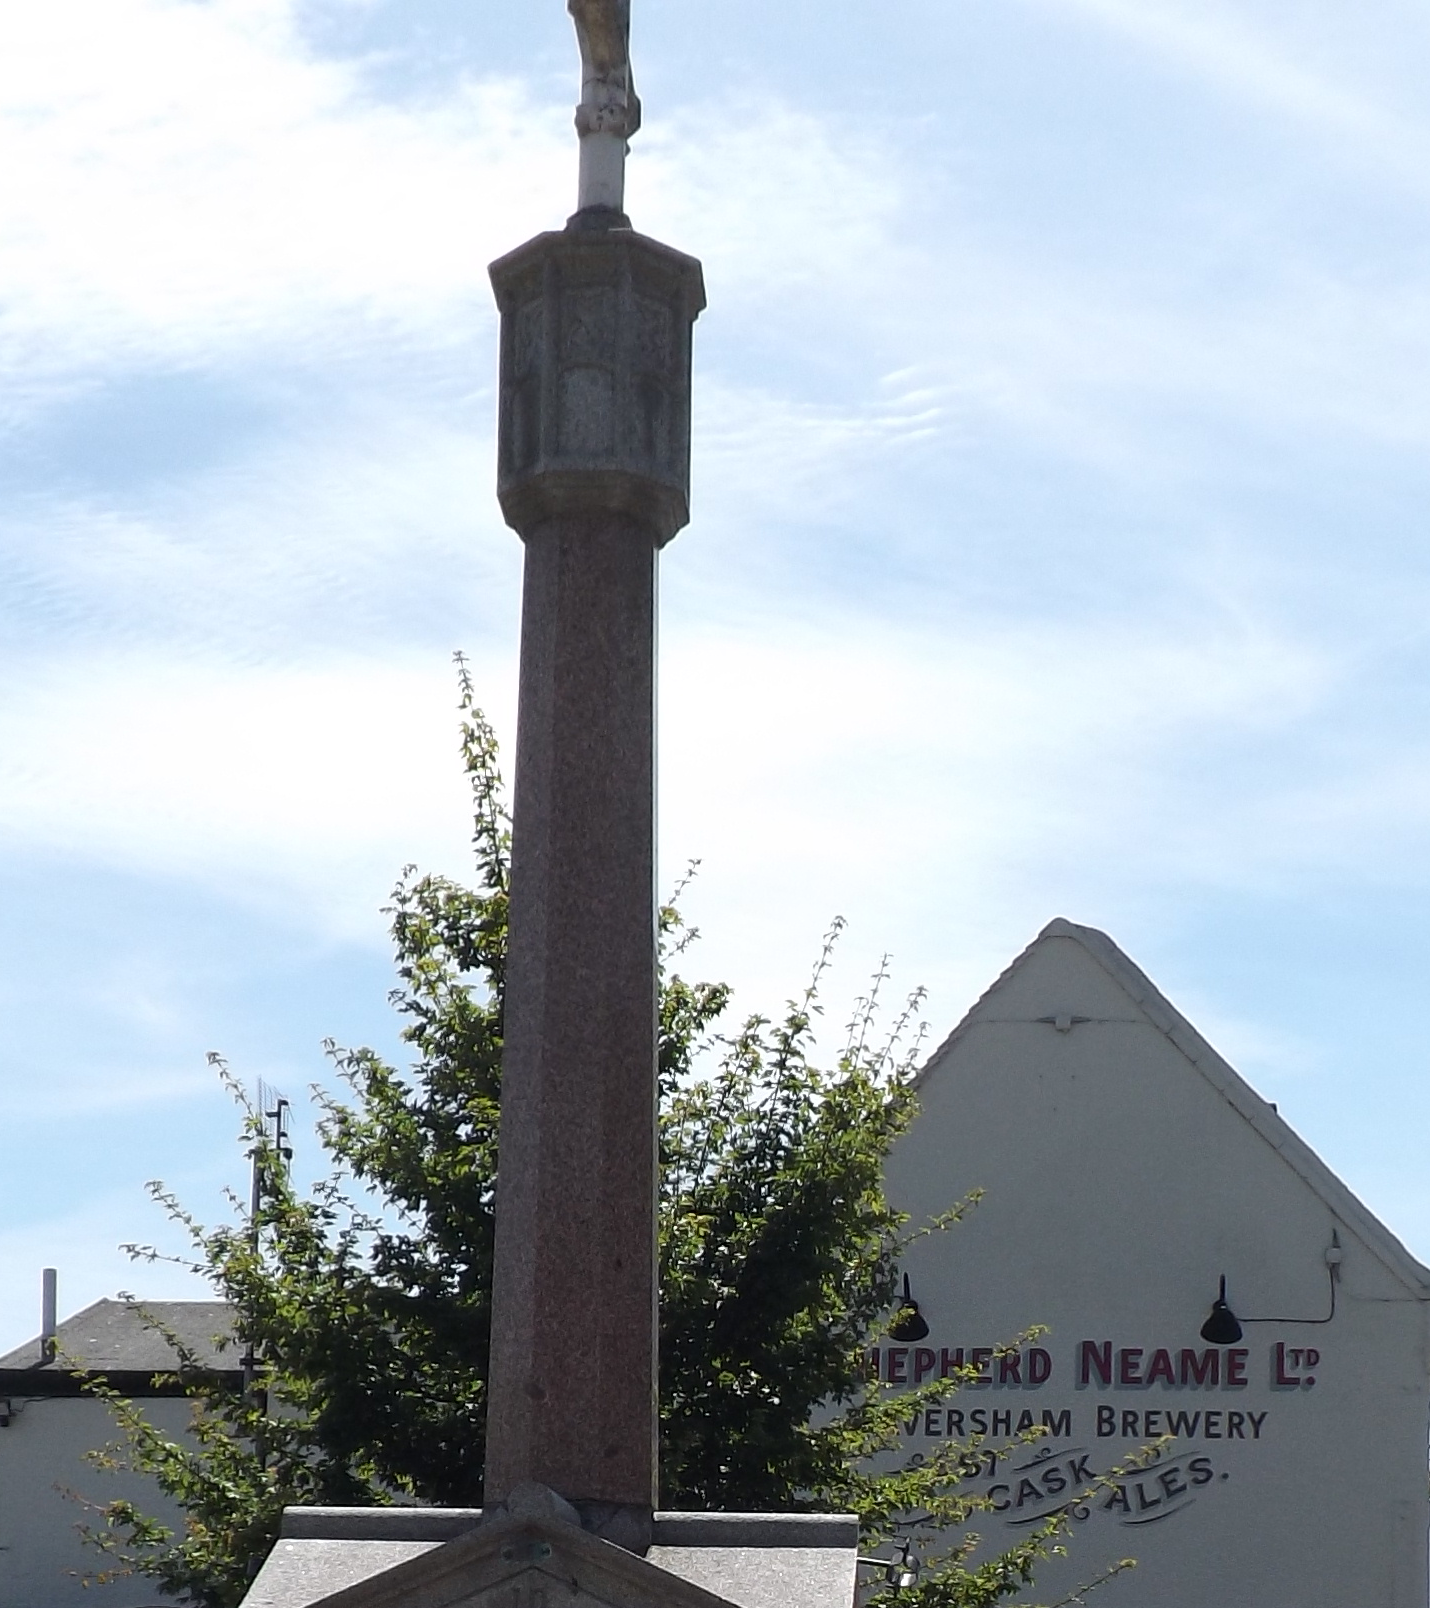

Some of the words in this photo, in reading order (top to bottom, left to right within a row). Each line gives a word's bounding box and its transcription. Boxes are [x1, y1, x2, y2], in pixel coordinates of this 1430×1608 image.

[858, 1346, 1053, 1388] HEPHERD
[1078, 1340, 1249, 1388] NEAME
[901, 1408, 1072, 1438] VERSHAM
[1096, 1406, 1269, 1440] BREWERY
[986, 1454, 1099, 1512] CASK
